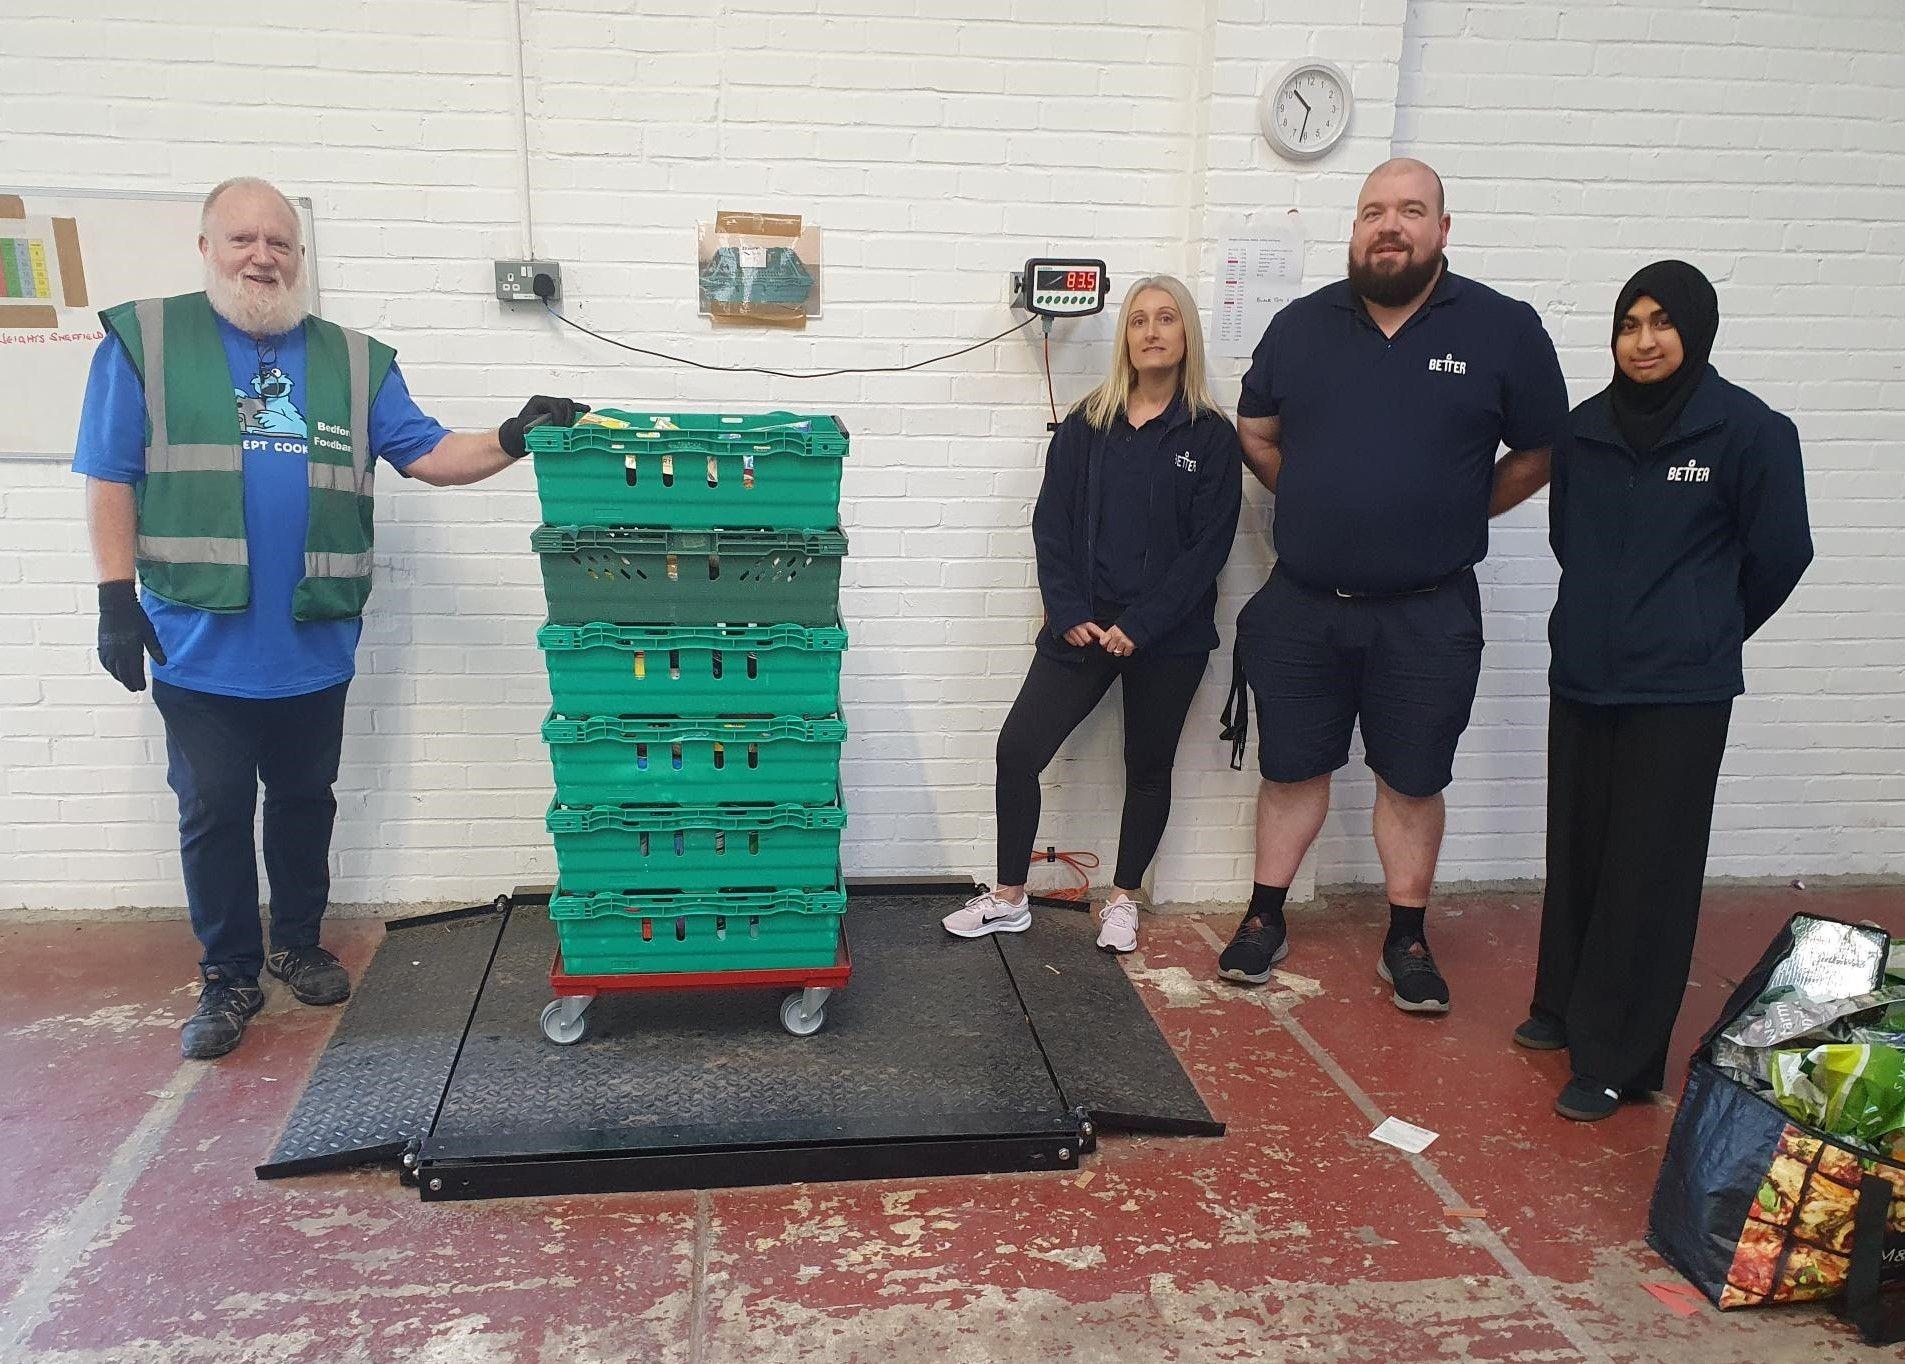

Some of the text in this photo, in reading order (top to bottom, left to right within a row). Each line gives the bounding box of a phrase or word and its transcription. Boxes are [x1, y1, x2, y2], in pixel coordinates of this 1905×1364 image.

[1307, 77, 1315, 86] 12
[1285, 91, 1293, 99] 10
[1066, 272, 1096, 289] 83.5
[1428, 354, 1467, 375] BETTER
[1666, 459, 1711, 482] BETTER
